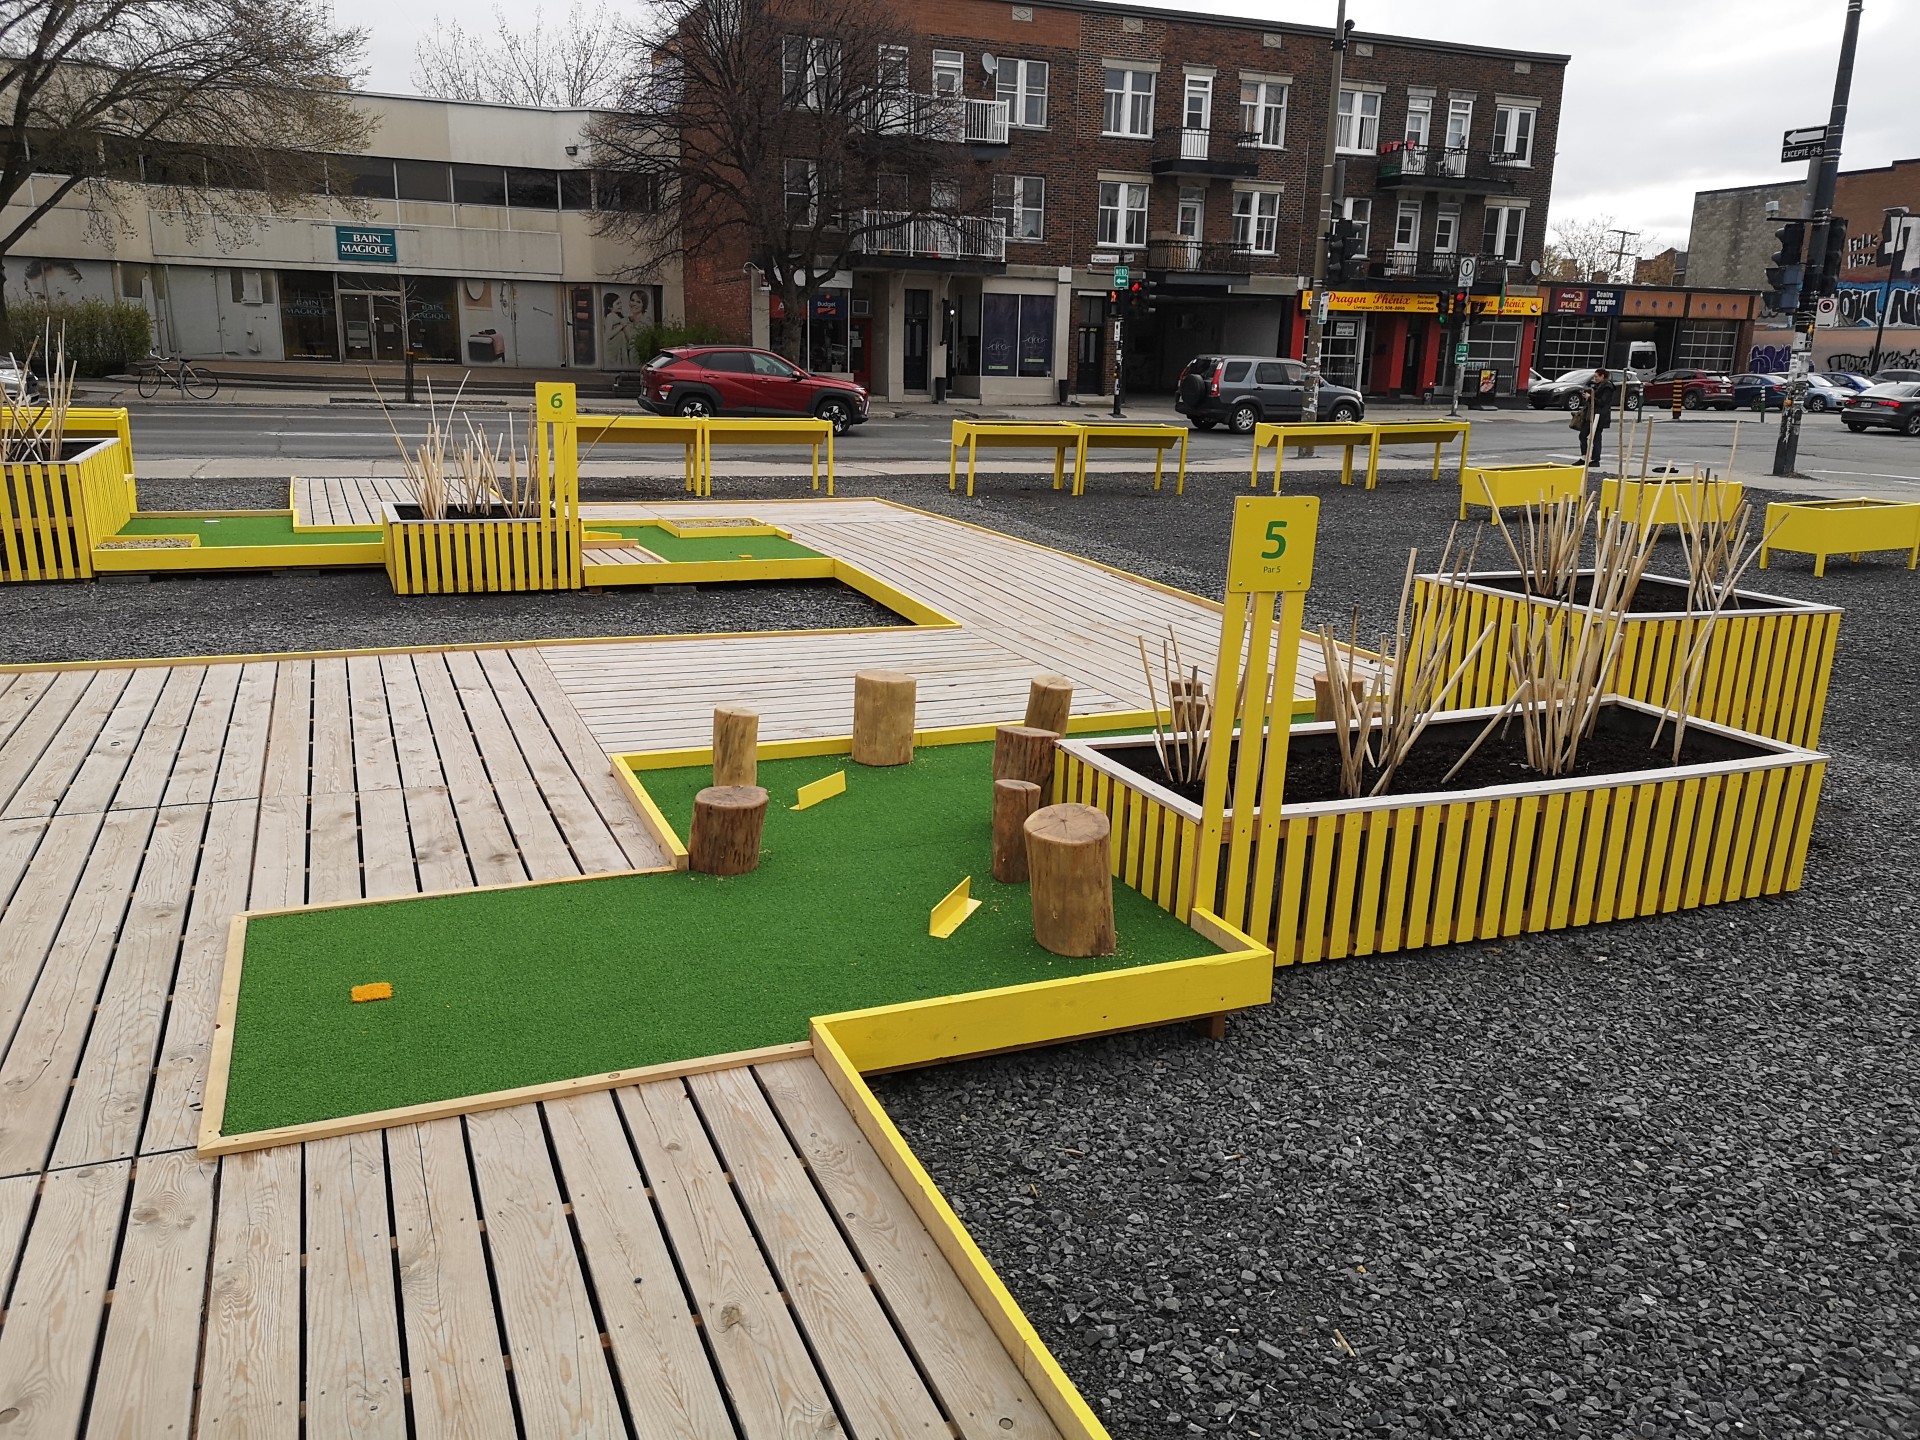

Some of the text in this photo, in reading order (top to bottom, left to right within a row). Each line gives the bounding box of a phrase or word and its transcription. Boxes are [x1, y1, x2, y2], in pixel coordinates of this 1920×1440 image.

[1783, 147, 1809, 159] EXCEPTÉ
[353, 234, 381, 243] BAIN
[341, 244, 391, 255] MAGIQUE
[1328, 291, 1411, 306] Dragon Phénix
[1504, 297, 1526, 308] hénix
[817, 301, 837, 309] Budget
[551, 392, 563, 409] 6
[1261, 520, 1288, 559] 5
